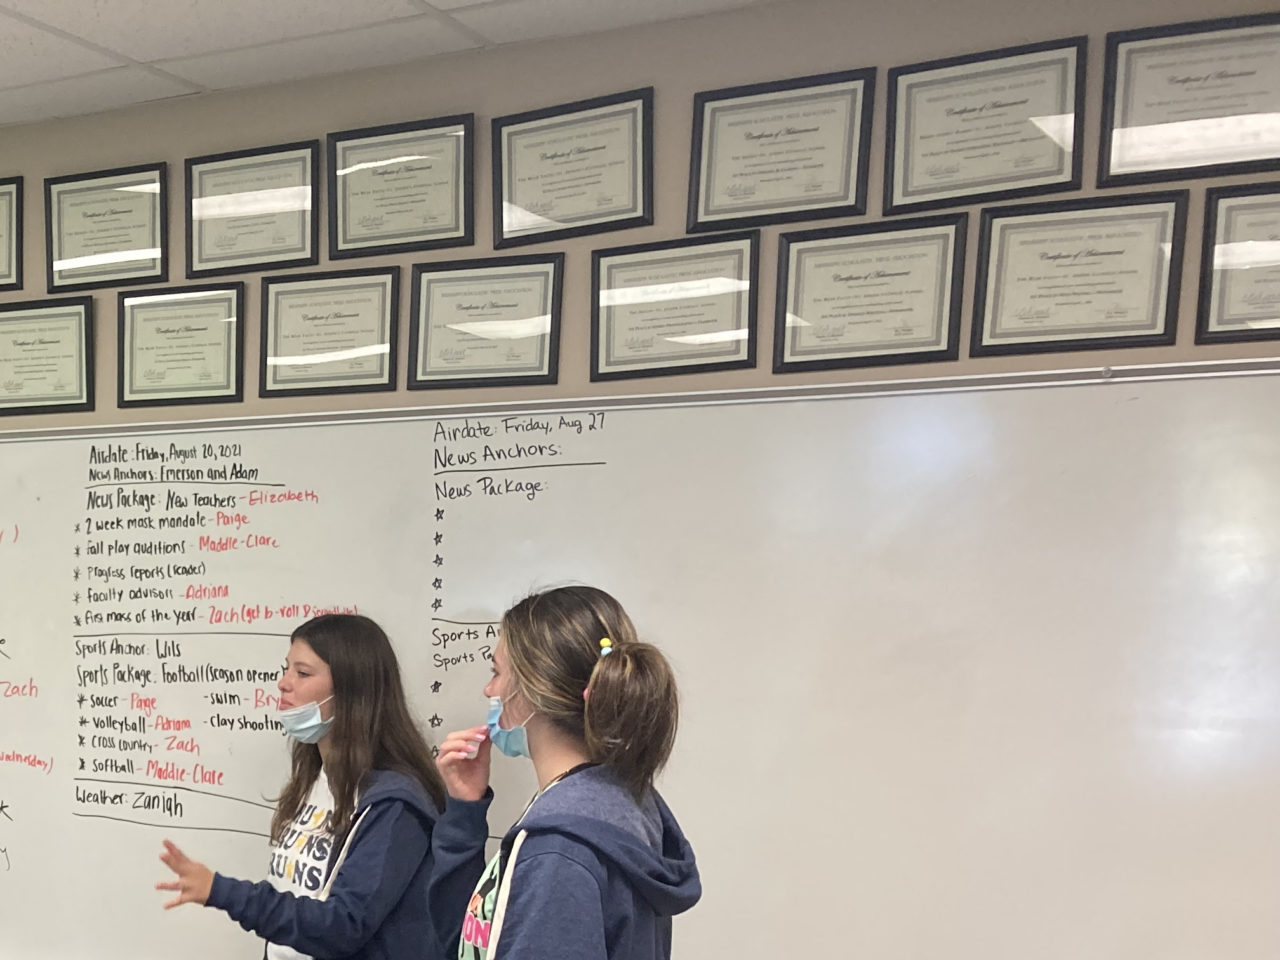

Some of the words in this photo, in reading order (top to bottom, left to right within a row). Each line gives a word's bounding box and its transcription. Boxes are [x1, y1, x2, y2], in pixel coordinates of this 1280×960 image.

[501, 417, 553, 435] Friday,
[559, 416, 582, 434] Aug
[588, 412, 605, 431] 27
[169, 442, 198, 465] August
[202, 443, 218, 461] 20,
[219, 444, 241, 458] 2021
[434, 446, 478, 469] News
[482, 443, 562, 461] Anchors:
[89, 468, 111, 482] News
[160, 465, 204, 481] Emerson
[207, 465, 227, 481] and
[229, 462, 259, 480] Adam
[166, 489, 188, 511] New
[192, 492, 236, 508] Teachers
[248, 489, 319, 506] Elizabeth
[435, 480, 473, 501] News
[95, 516, 123, 531] week
[127, 515, 156, 530] mask
[159, 511, 206, 528] mandate
[216, 510, 251, 531] Paige
[108, 541, 129, 557] play
[133, 539, 186, 555] auditions
[185, 583, 230, 600] Adriana
[107, 610, 132, 623] mass
[135, 608, 147, 624] of
[151, 608, 171, 623] the
[173, 606, 197, 626] year
[208, 605, 238, 624] Zach
[432, 627, 478, 648] Sports
[75, 640, 106, 660] Sports
[156, 638, 182, 660] Wils
[433, 651, 475, 671] Sports
[77, 664, 110, 687] Sports
[130, 692, 158, 718] Paige
[92, 714, 146, 737] Volleyball
[165, 735, 200, 758] Zach
[145, 759, 225, 786] Maddie-Clare
